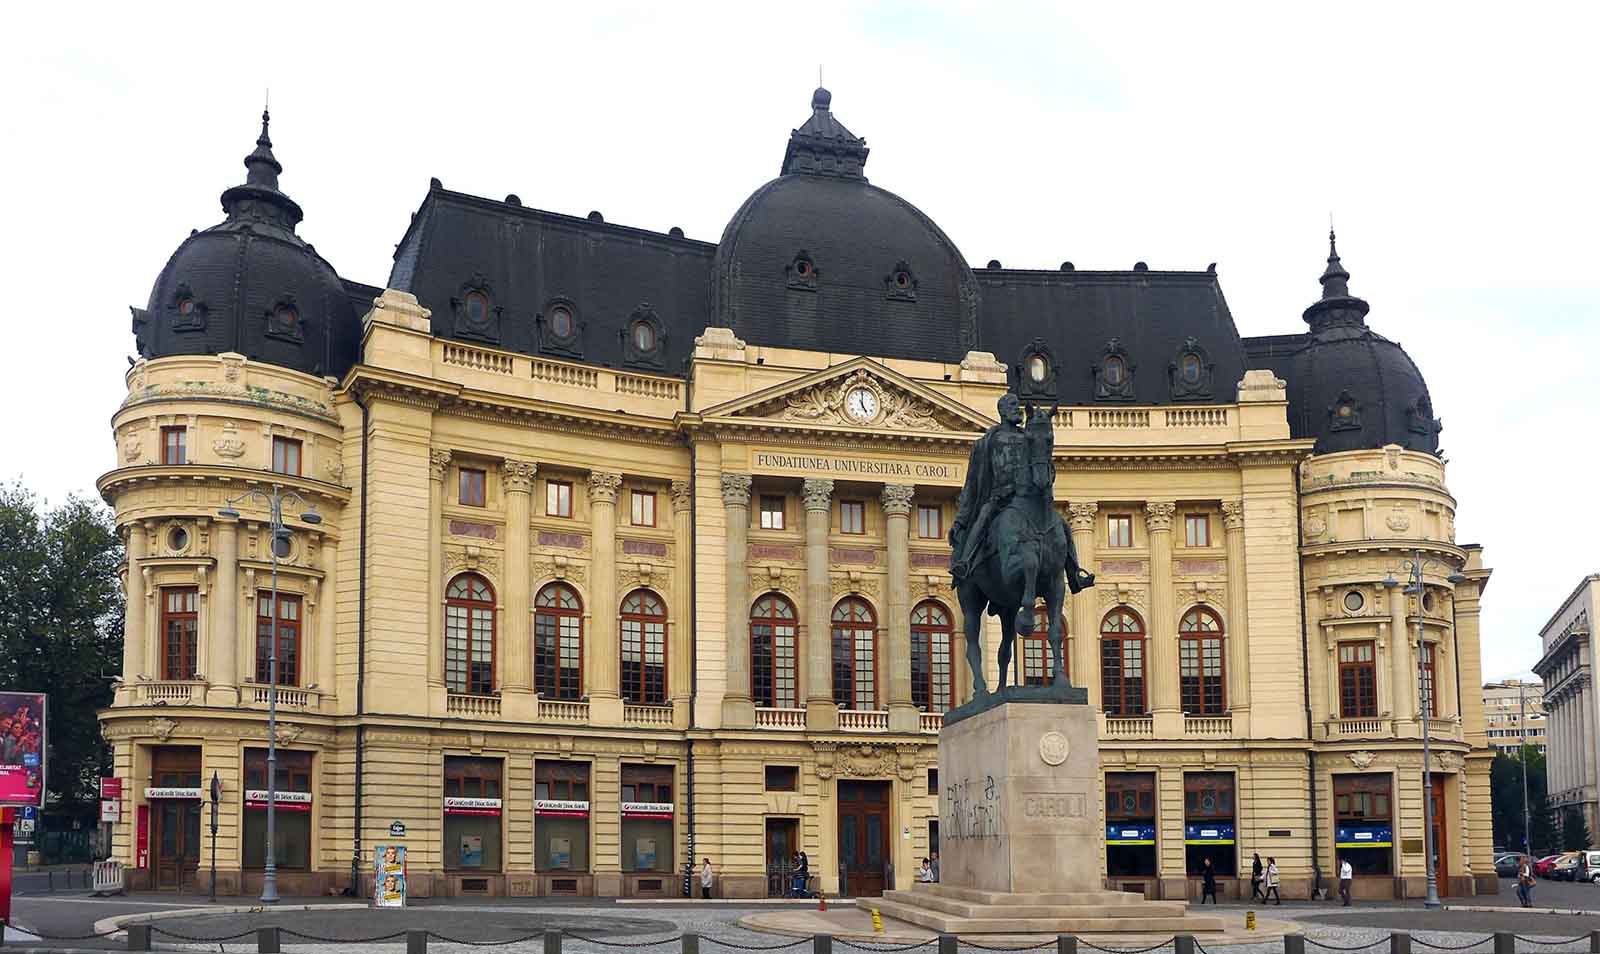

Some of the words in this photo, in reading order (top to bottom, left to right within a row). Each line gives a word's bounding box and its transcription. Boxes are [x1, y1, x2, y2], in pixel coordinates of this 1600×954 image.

[757, 454, 831, 471] FUNDATIUNEA
[834, 459, 912, 476] UNIVERSITARA
[915, 464, 949, 479] CAROL
[25, 806, 32, 817] P
